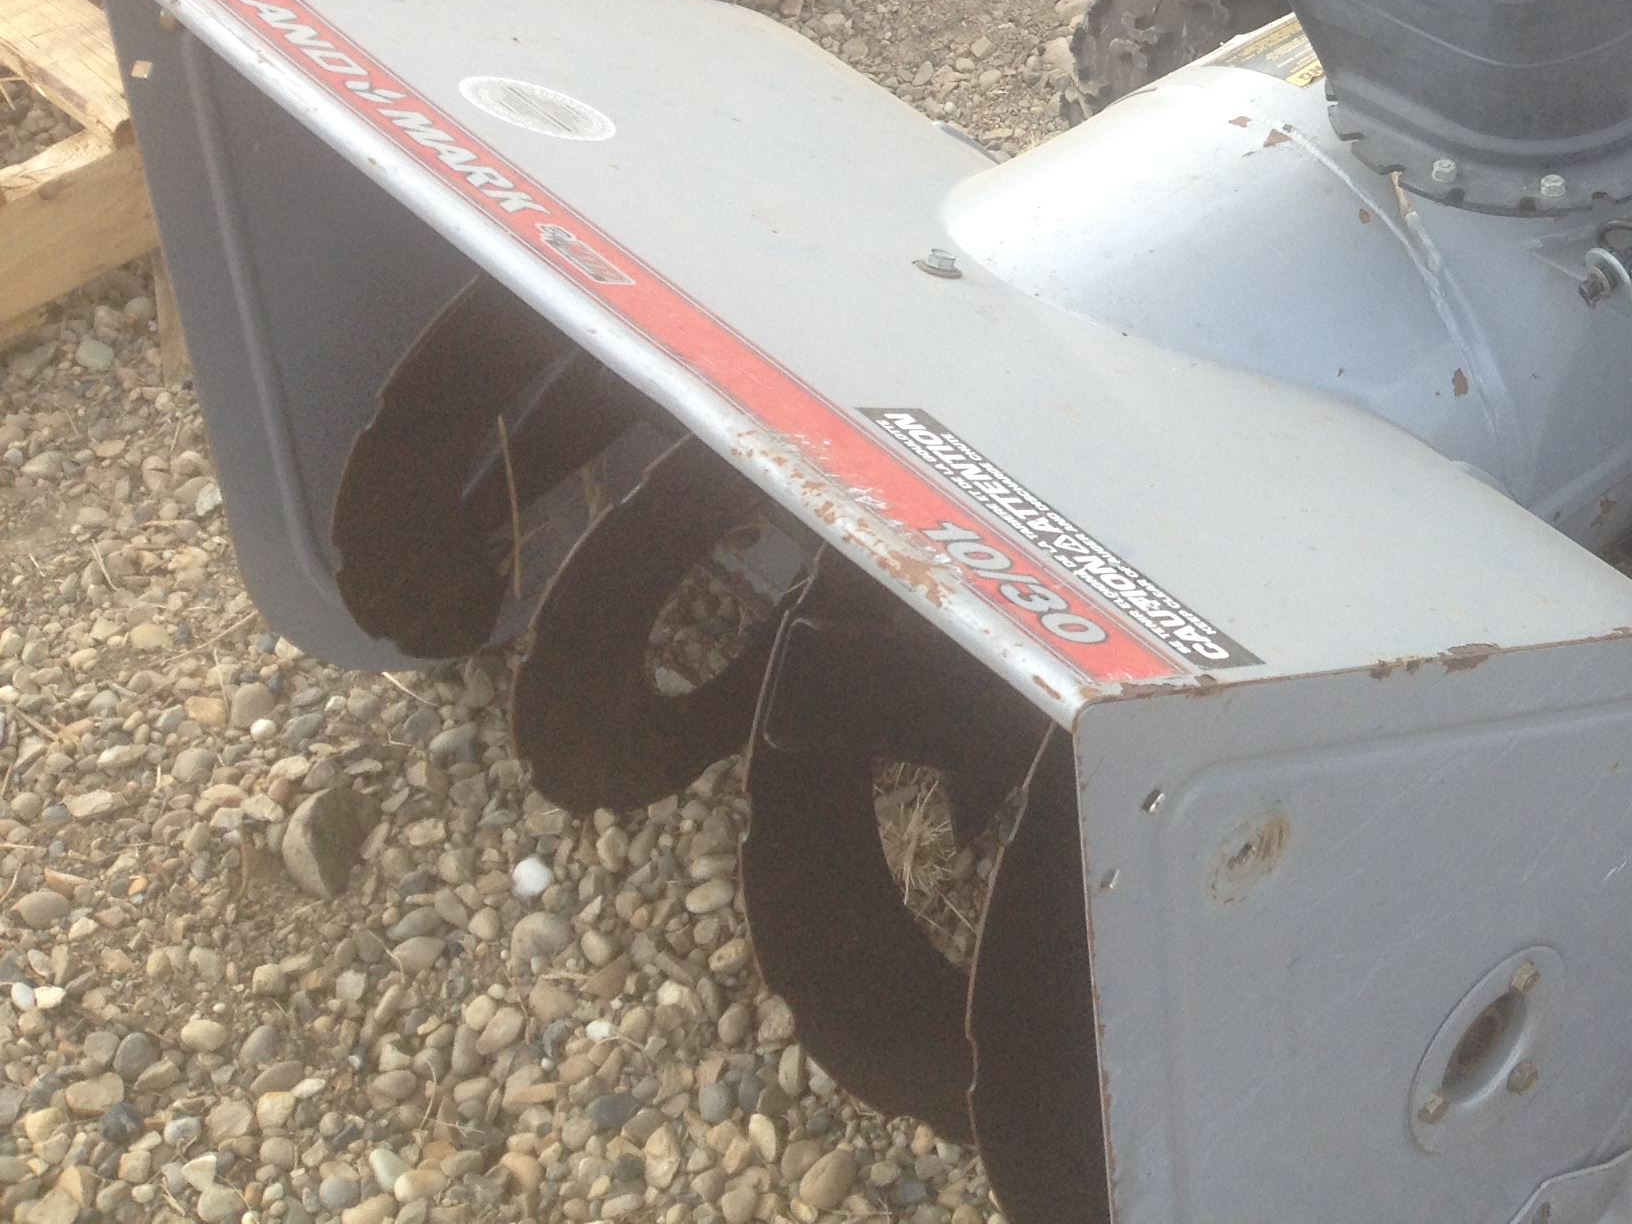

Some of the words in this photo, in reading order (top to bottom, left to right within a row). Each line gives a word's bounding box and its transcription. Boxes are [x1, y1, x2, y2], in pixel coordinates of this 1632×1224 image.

[872, 419, 940, 461] GOULOTTE
[878, 413, 1067, 534] ATTENTION
[931, 463, 956, 474] LA
[949, 477, 975, 488] DE
[965, 489, 991, 501] ET
[975, 462, 1052, 510] DISCHARGE
[1042, 512, 1080, 531] AND
[1052, 555, 1079, 567] DE
[1071, 533, 1123, 564] AUGER
[916, 520, 1109, 644] 10/30
[1133, 578, 1183, 608] CLEAR
[1069, 554, 1234, 660] CAUTION
[1125, 610, 1173, 638] TENIR
[1174, 609, 1219, 634] KEEP
[1166, 640, 1193, 653] SE
